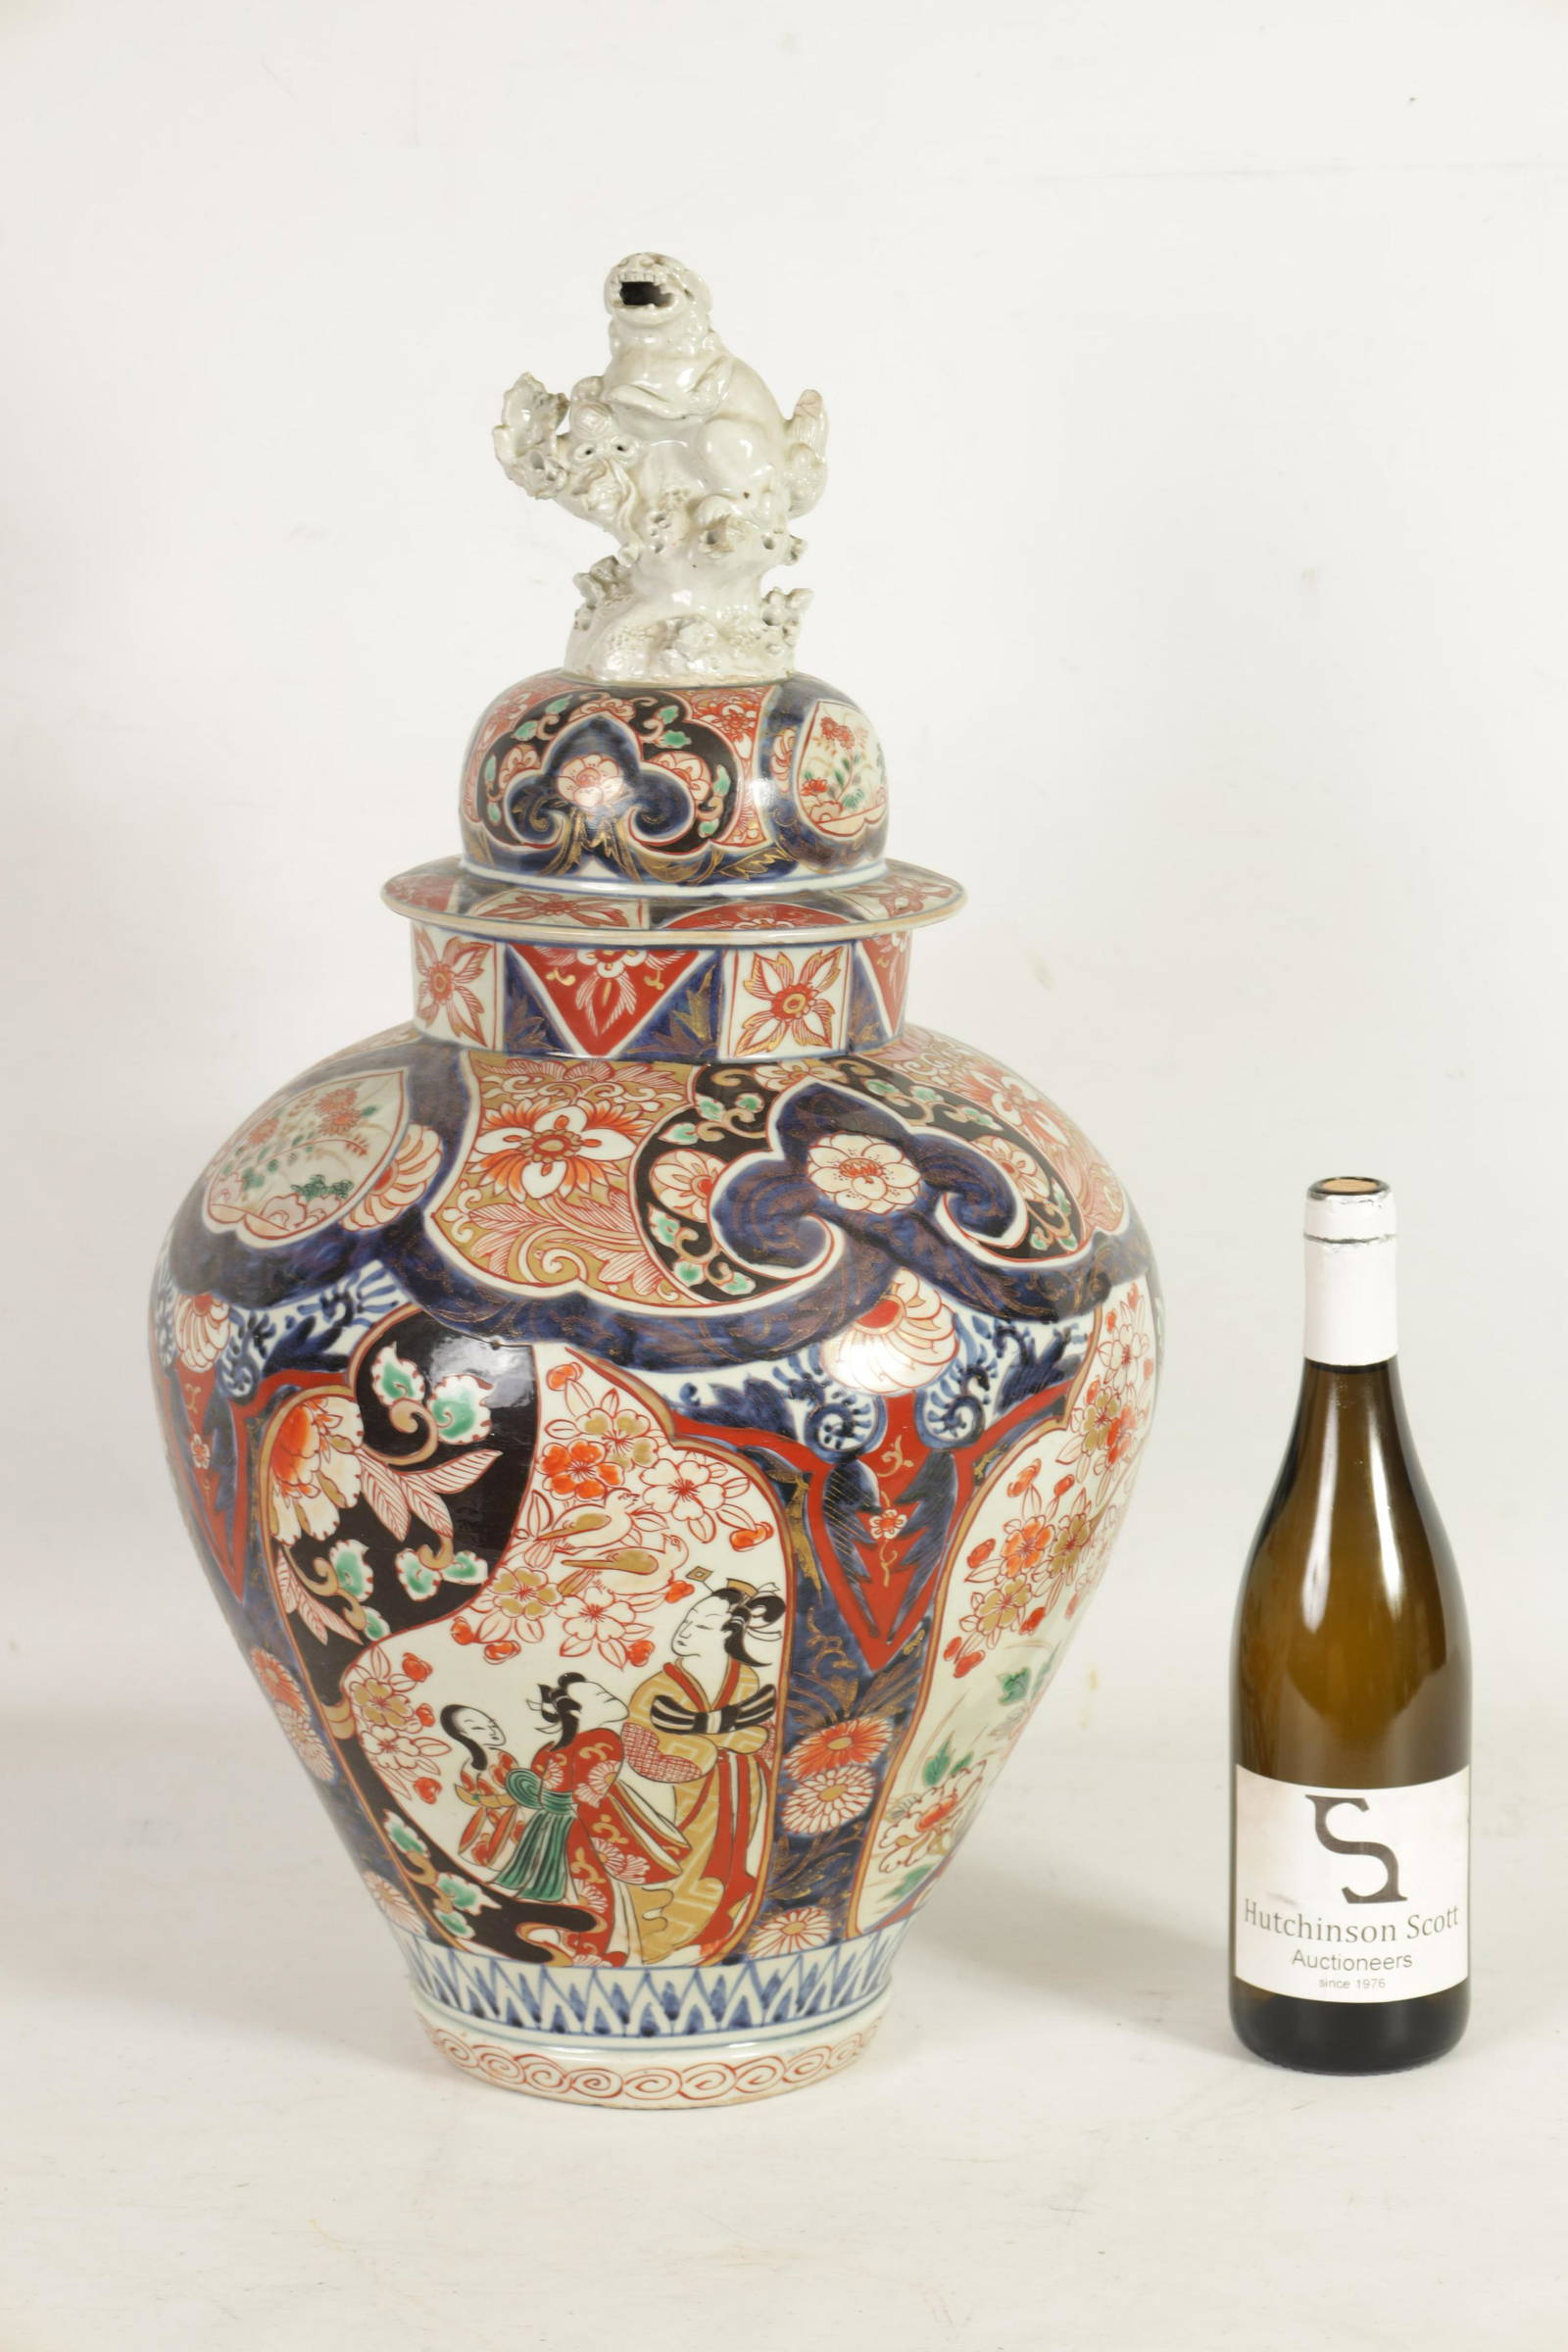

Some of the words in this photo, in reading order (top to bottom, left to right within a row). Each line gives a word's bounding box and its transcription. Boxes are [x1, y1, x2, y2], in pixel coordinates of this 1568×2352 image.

[1243, 1897, 1397, 1943] Hutchinson
[1406, 1905, 1460, 1940] Scott
[1292, 1949, 1413, 1972] Auctioneers
[1318, 1978, 1350, 1989] since
[1356, 1978, 1387, 1989] 1976
